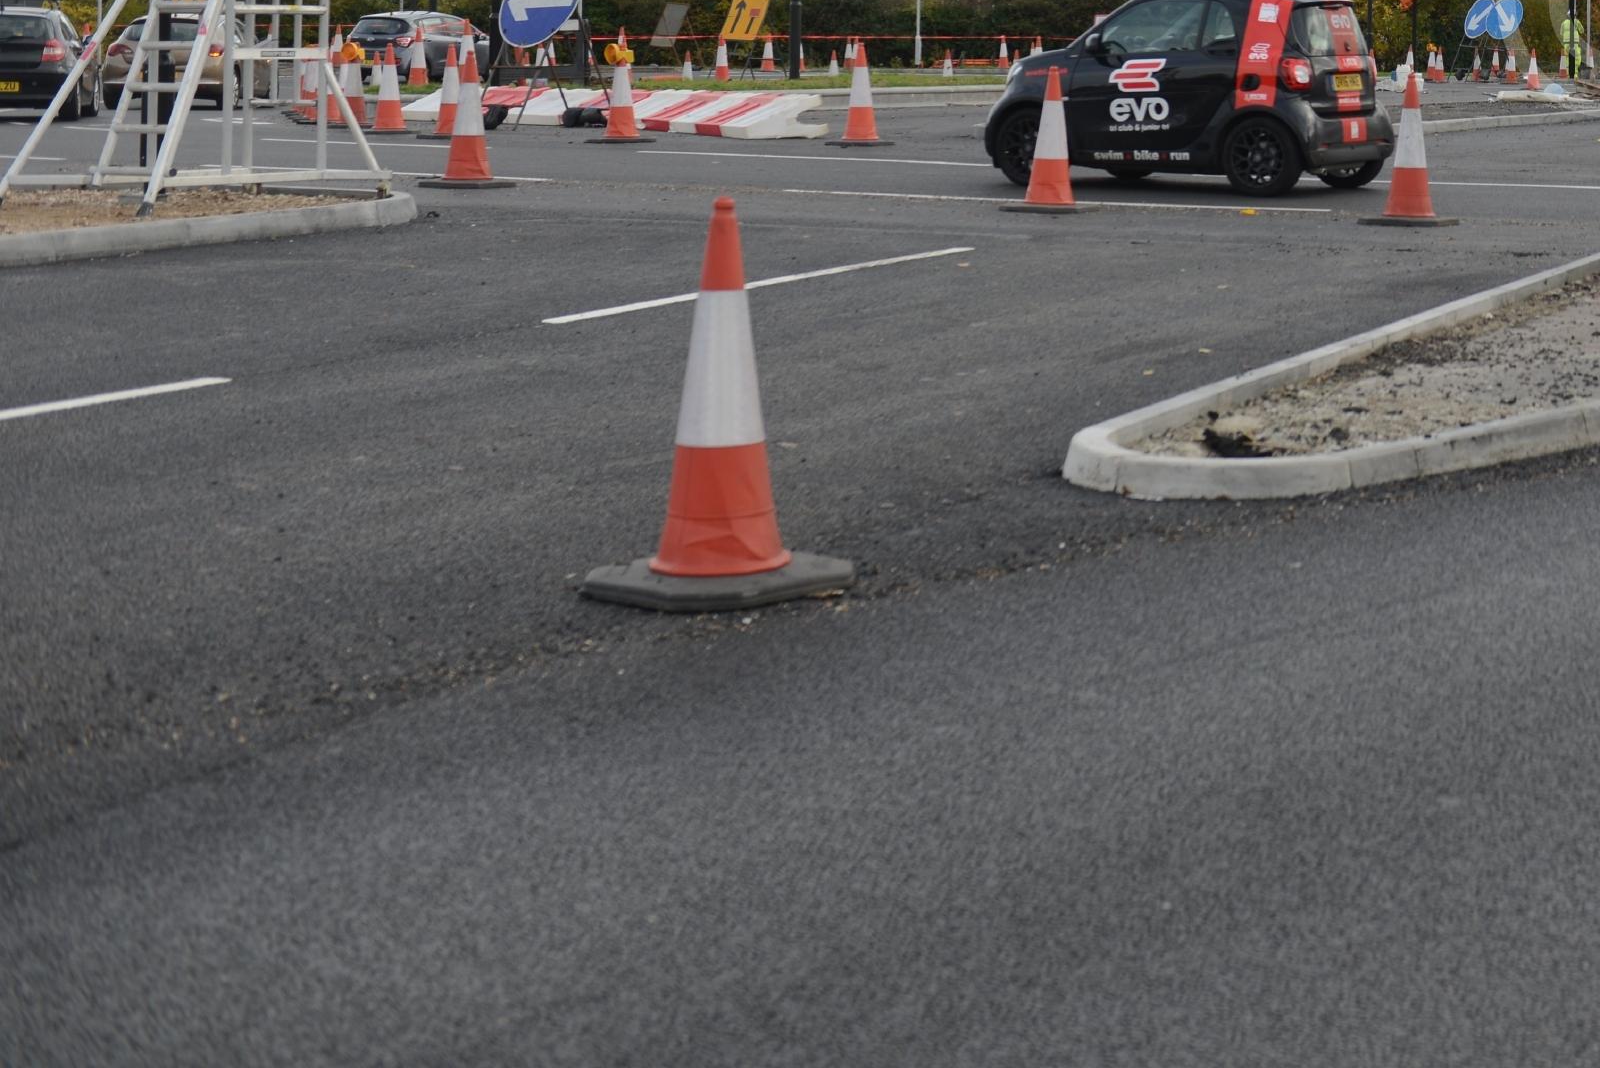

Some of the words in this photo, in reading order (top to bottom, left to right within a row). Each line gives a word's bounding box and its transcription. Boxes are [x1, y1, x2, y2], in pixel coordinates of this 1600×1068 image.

[1248, 52, 1269, 60] evo
[1109, 97, 1170, 122] evo
[1118, 124, 1134, 132] club
[1141, 123, 1160, 132] junior
[1094, 150, 1124, 161] swim
[1133, 150, 1159, 161] bike
[1170, 152, 1190, 161] run
